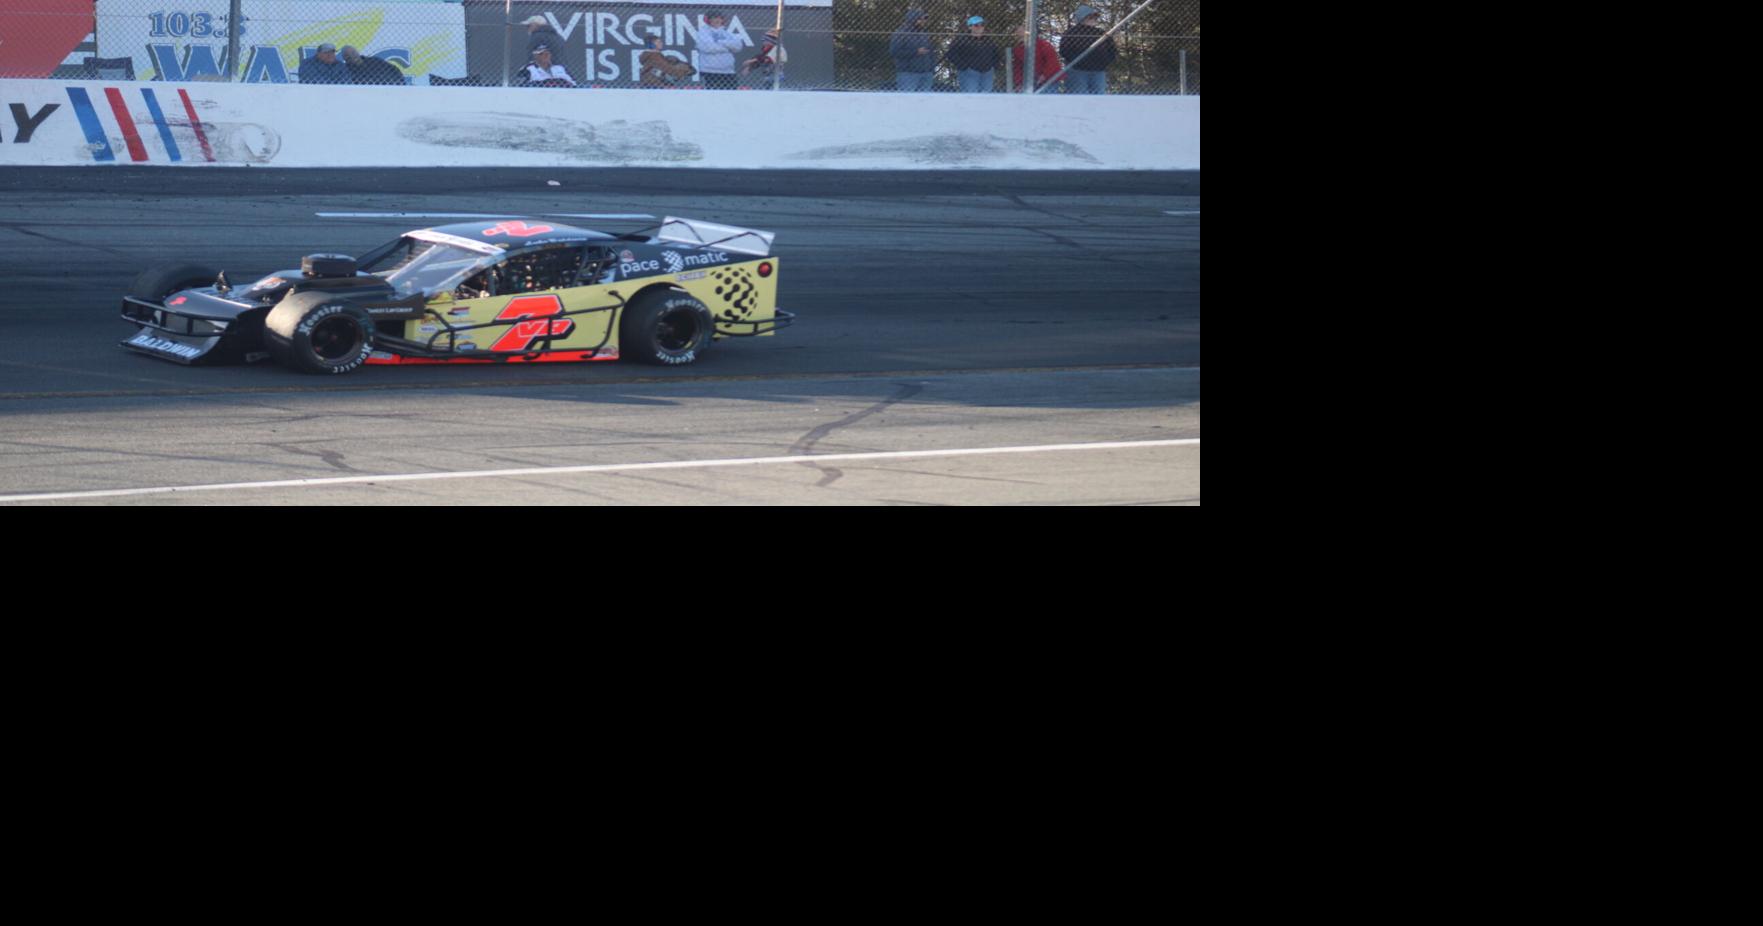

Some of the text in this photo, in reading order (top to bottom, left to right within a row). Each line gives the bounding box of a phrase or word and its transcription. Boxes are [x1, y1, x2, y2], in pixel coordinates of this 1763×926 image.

[543, 12, 755, 47] VIRGINA
[145, 43, 416, 85] WA
[585, 48, 621, 81] IS
[0, 103, 61, 144] Y
[620, 259, 660, 278] pace
[684, 252, 729, 266] matic
[130, 335, 201, 359] BALDWIN
